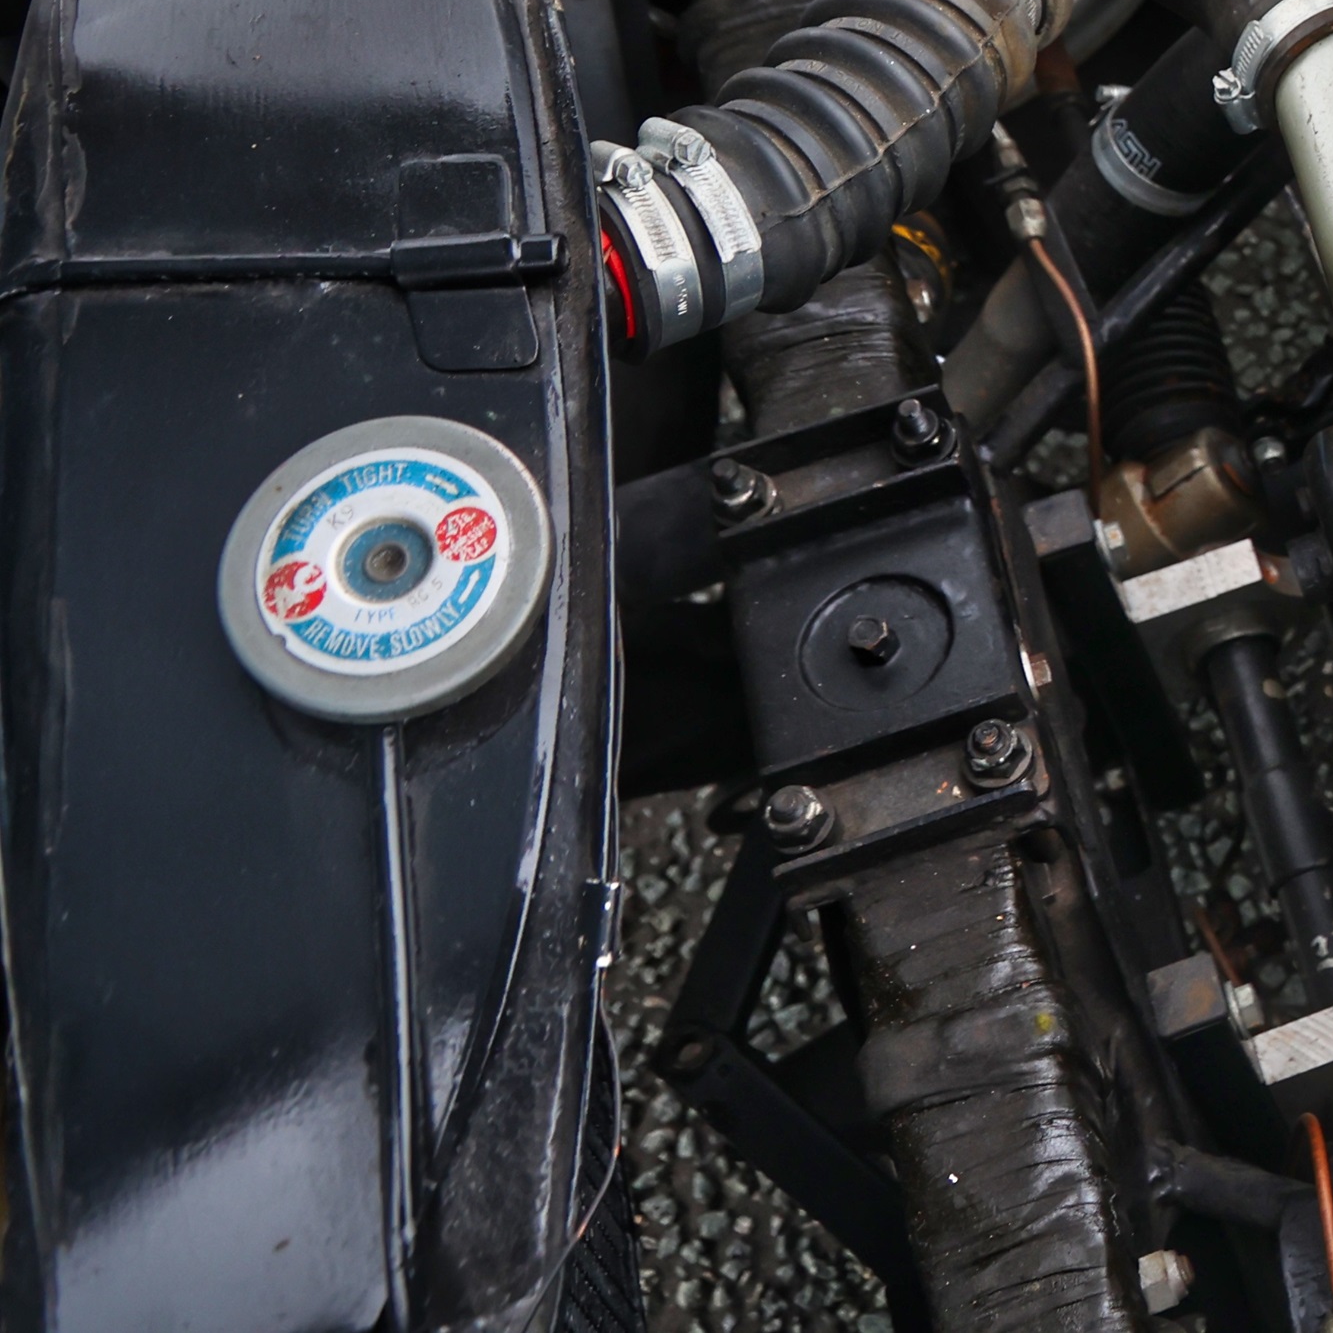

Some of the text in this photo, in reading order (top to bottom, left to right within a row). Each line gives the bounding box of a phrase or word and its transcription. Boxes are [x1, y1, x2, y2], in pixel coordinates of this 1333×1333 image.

[282, 462, 407, 543] TURN TIGHT
[303, 601, 458, 661] REMOVE SLOWLY
